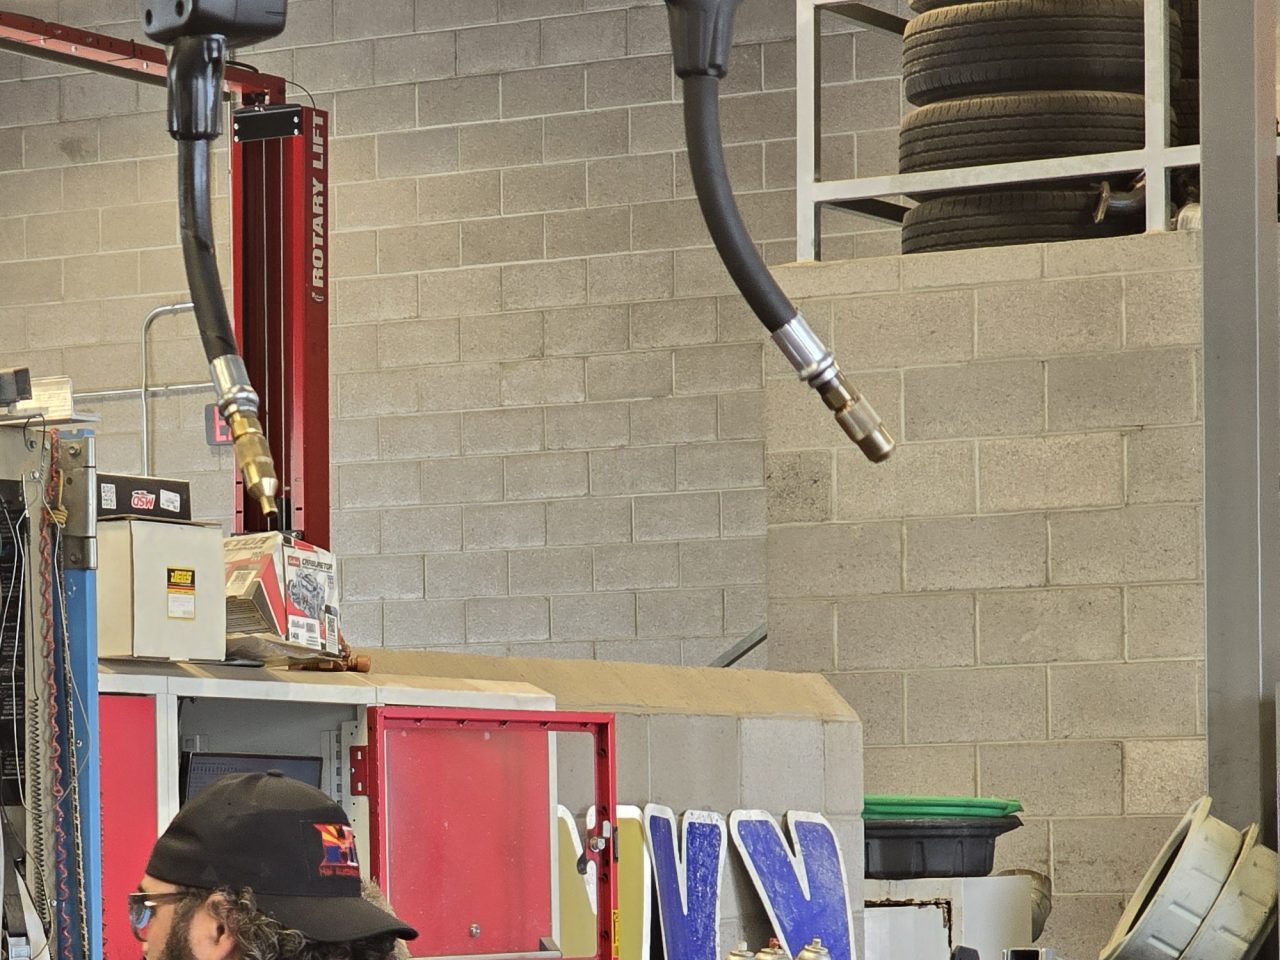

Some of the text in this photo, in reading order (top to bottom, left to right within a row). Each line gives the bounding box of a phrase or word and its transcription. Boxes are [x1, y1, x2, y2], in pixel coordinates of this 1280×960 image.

[312, 111, 324, 288] ROTARY LIFT
[132, 496, 155, 510] MSD
[302, 558, 333, 571] CARBURETOR
